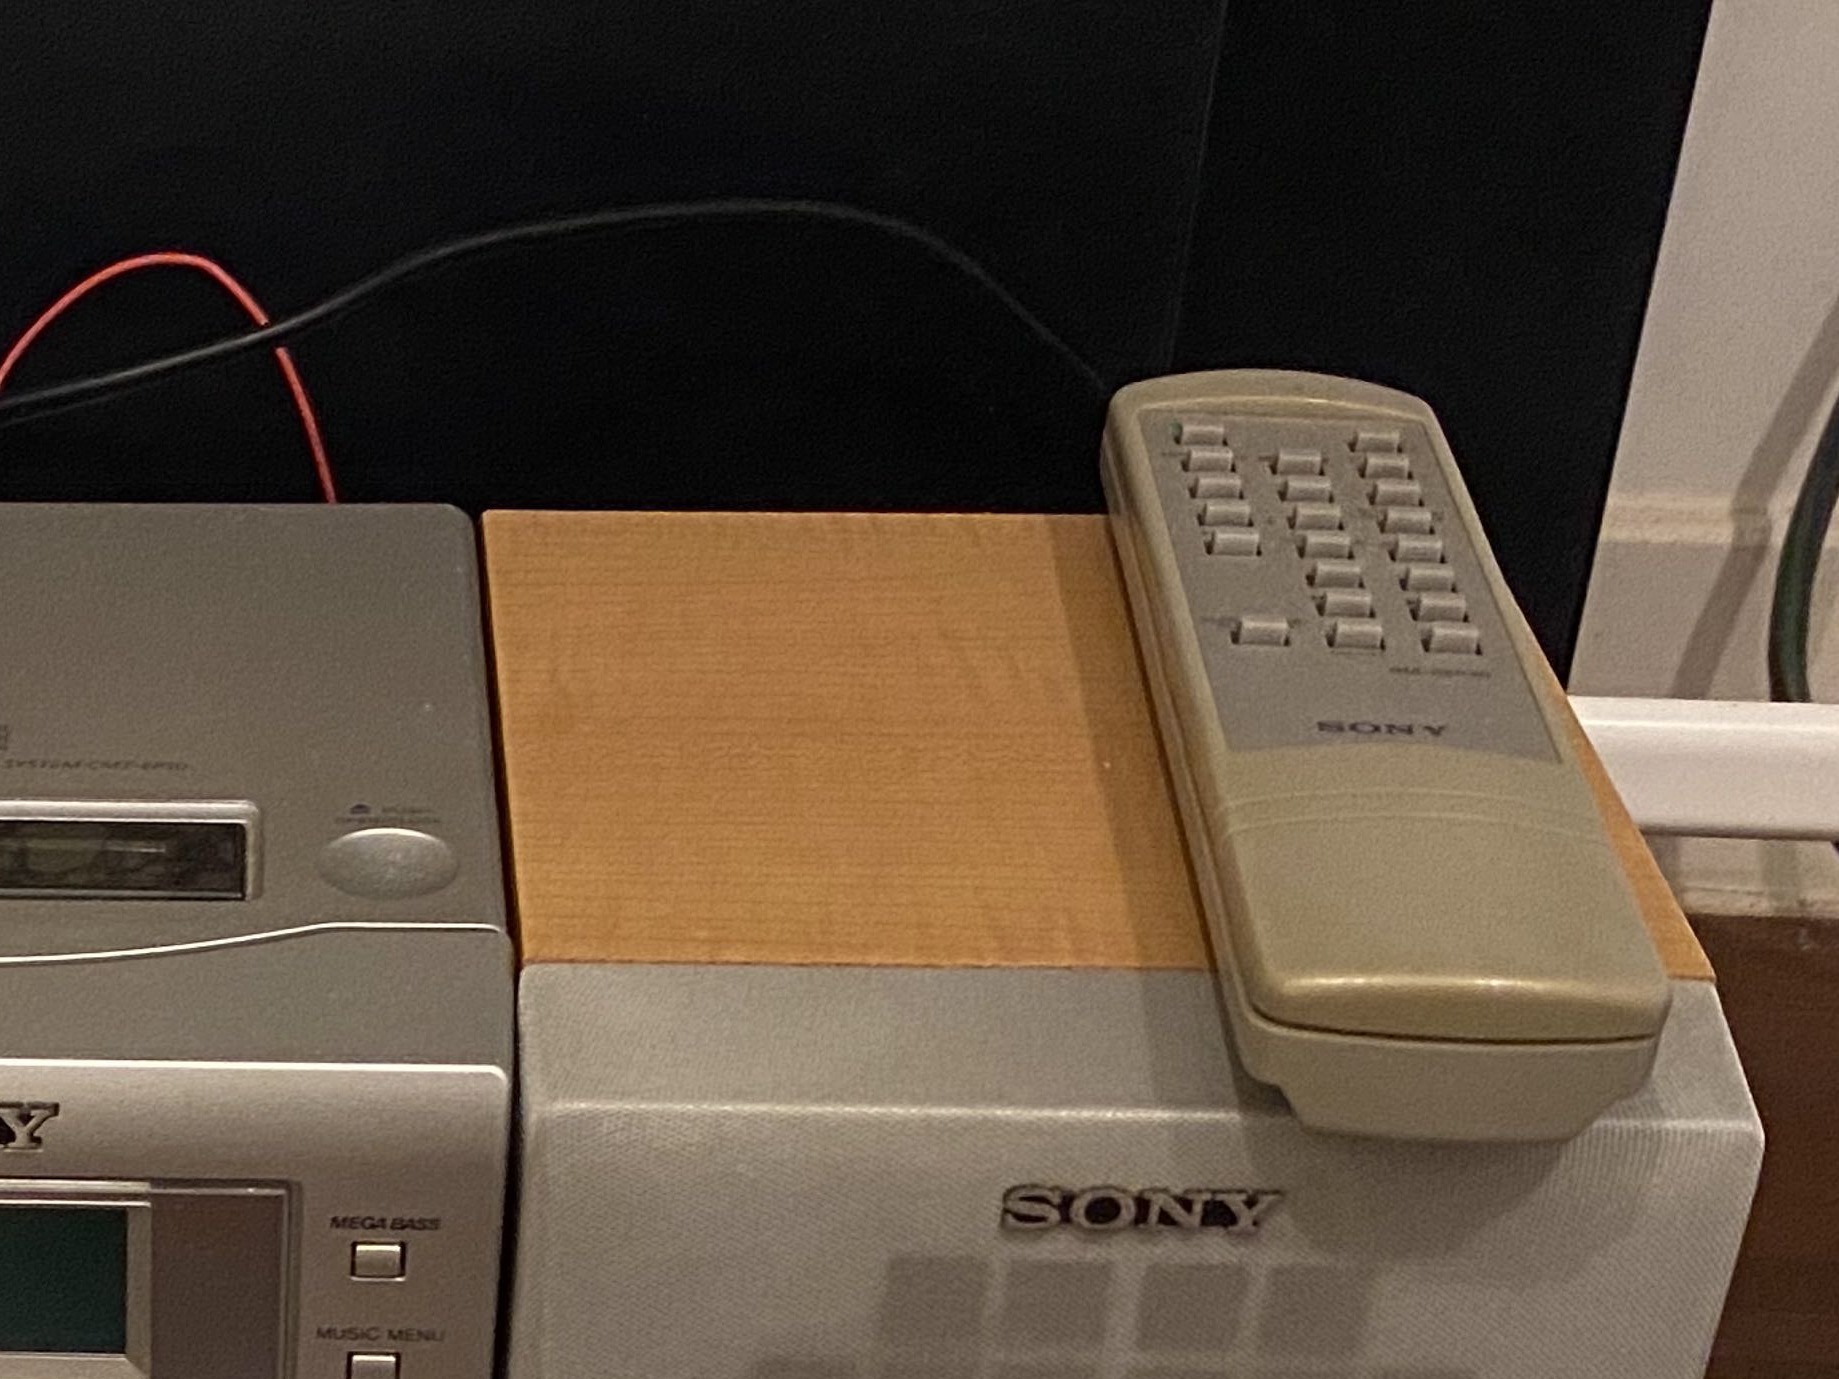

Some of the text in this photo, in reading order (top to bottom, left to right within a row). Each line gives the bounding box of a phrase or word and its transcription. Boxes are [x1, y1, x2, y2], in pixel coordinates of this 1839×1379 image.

[1317, 721, 1448, 736] SONY
[1001, 1184, 1283, 1231] SONY
[329, 1215, 442, 1232] MEGA BASS
[315, 1326, 446, 1343] MUSIC MENU
